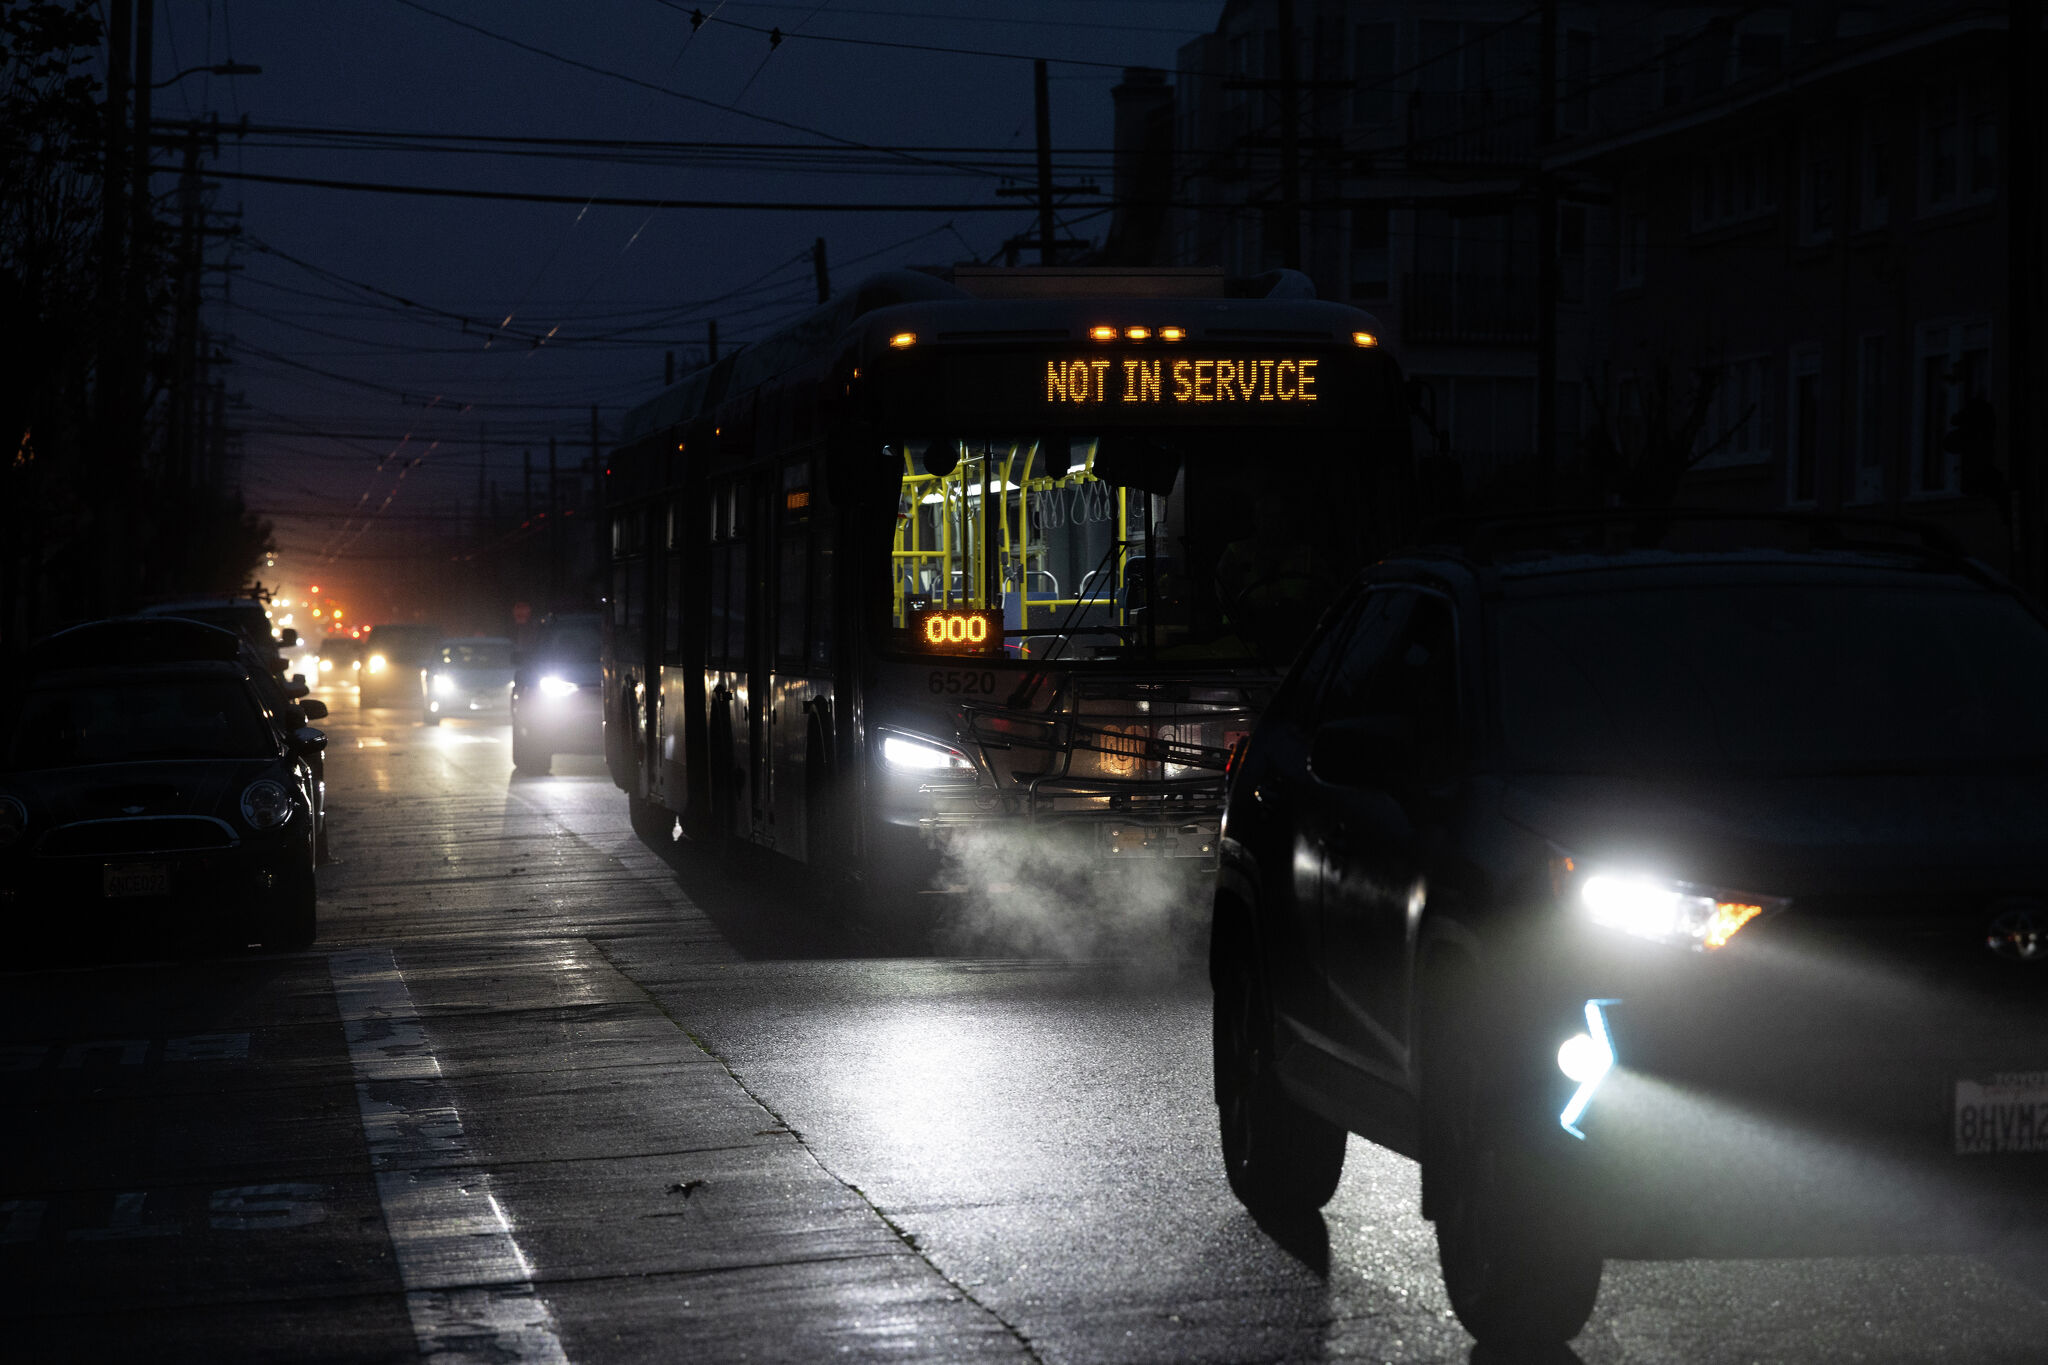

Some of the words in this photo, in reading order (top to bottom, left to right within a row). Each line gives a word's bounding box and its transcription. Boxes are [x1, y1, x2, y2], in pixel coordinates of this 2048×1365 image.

[1048, 361, 1110, 402] NOT
[1124, 361, 1160, 402] IN
[1173, 360, 1319, 402] SERVICE
[926, 615, 987, 643] 000
[928, 671, 996, 694] 6520
